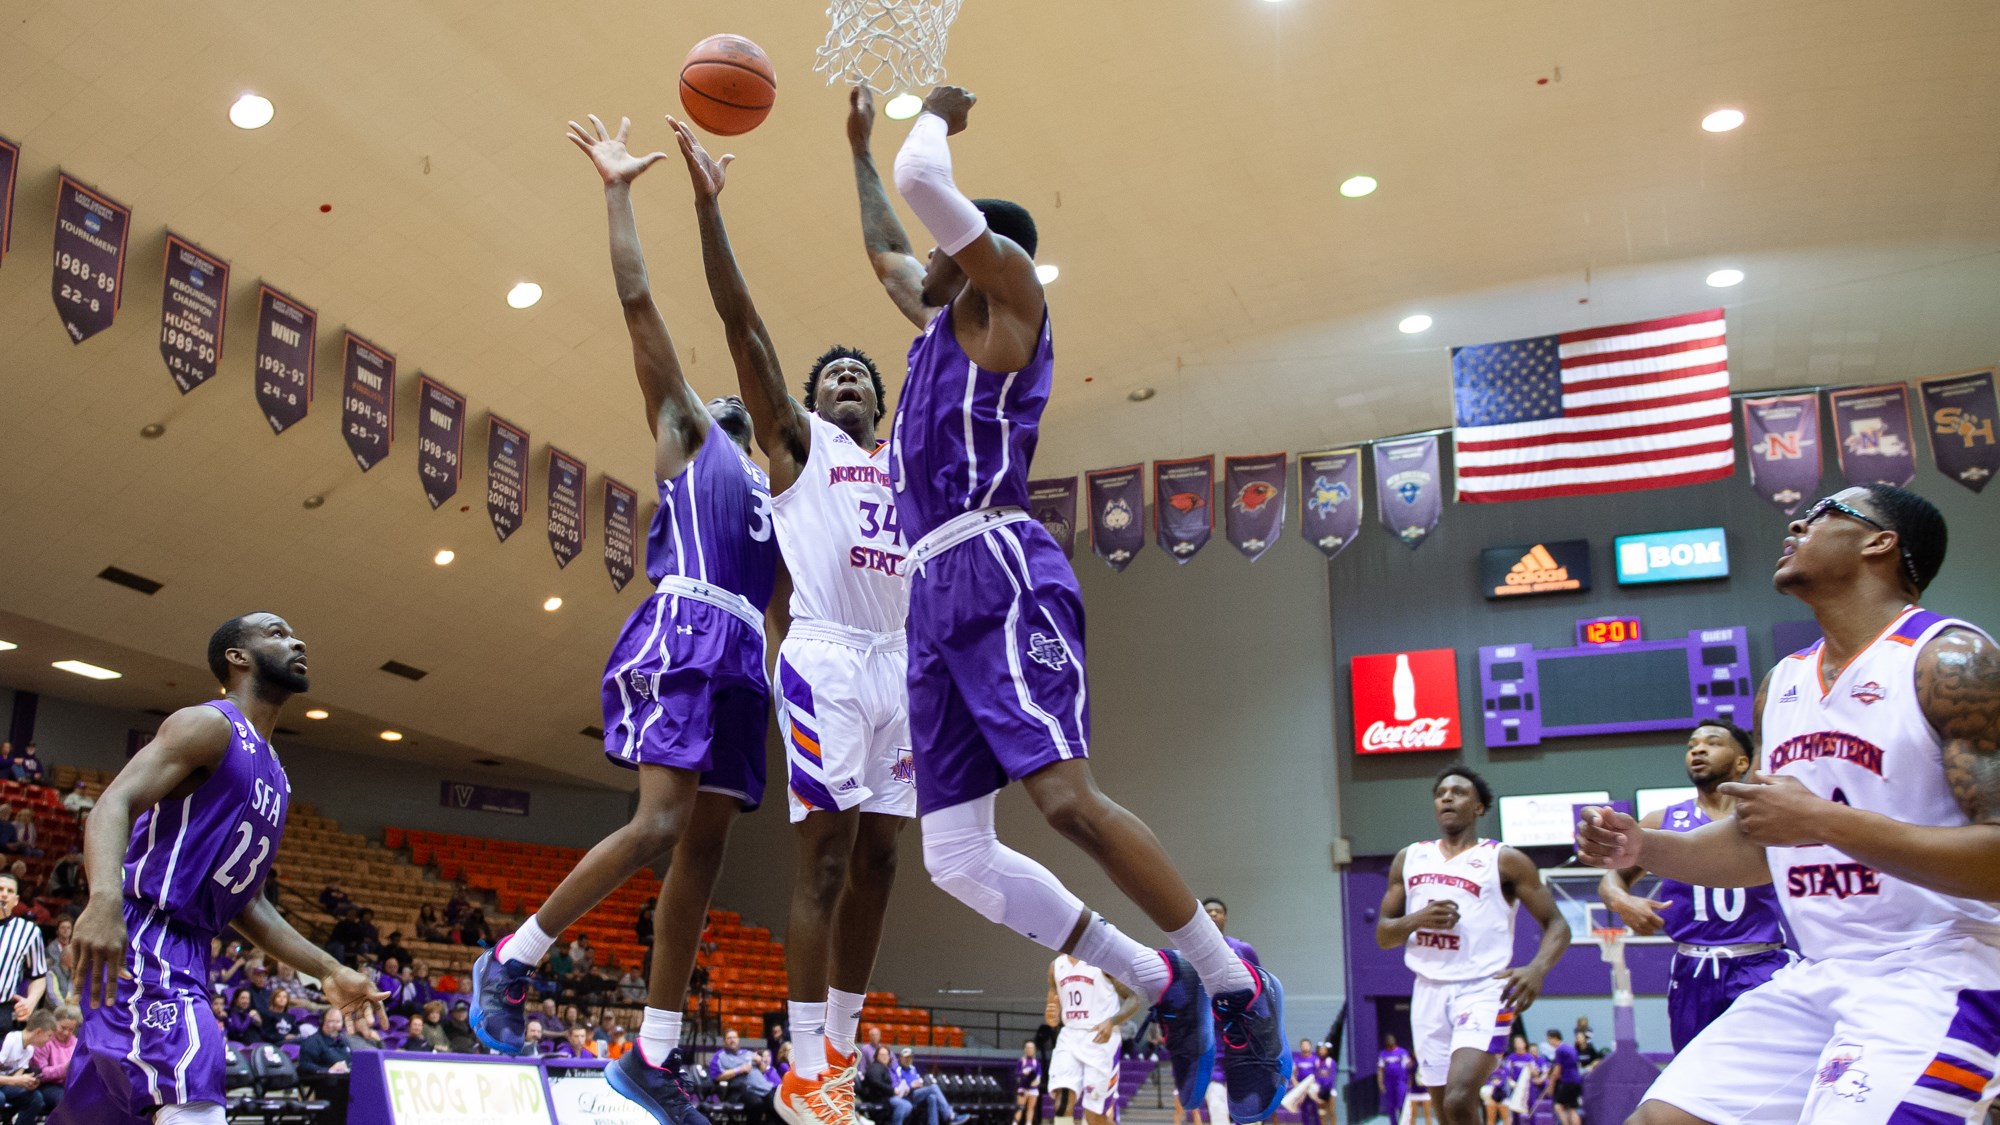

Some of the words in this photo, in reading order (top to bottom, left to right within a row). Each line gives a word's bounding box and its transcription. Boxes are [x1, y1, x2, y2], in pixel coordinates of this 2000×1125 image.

[60, 219, 118, 256] TOURNAMENT
[55, 251, 115, 293] 1988-89
[60, 284, 100, 312] 22-8
[169, 277, 217, 308] REBOUNDING
[172, 292, 213, 318] CHAMPION
[165, 312, 214, 344] HUDSON
[183, 310, 201, 326] PAM
[162, 327, 215, 364] 1989-90
[169, 355, 190, 373] 15.1
[259, 354, 305, 387] 1992-93
[263, 381, 297, 406] 24-8
[345, 396, 388, 429] 1994-95
[350, 423, 380, 445] 25-7
[1768, 433, 1799, 459] N
[1861, 431, 1880, 449] N
[419, 437, 457, 467] 1998-99
[424, 463, 449, 483] 22-7
[492, 479, 517, 499] DOBIN
[489, 490, 520, 516] 2001-02
[551, 509, 576, 527] DOBIN
[859, 500, 901, 547] 34
[548, 520, 579, 543] 2002-03
[604, 546, 632, 567] 2003-04
[608, 537, 629, 553] DOBIN
[1649, 542, 1722, 568] BOM
[1701, 630, 1733, 642] GUEST
[251, 777, 281, 829] SFA
[213, 821, 271, 895] 23
[1787, 863, 1881, 899] STATE
[1693, 885, 1746, 923] 10
[1416, 930, 1461, 951] STATE
[1069, 990, 1082, 1007] 10
[389, 1069, 468, 1115] FROG
[476, 1073, 541, 1115] PND
